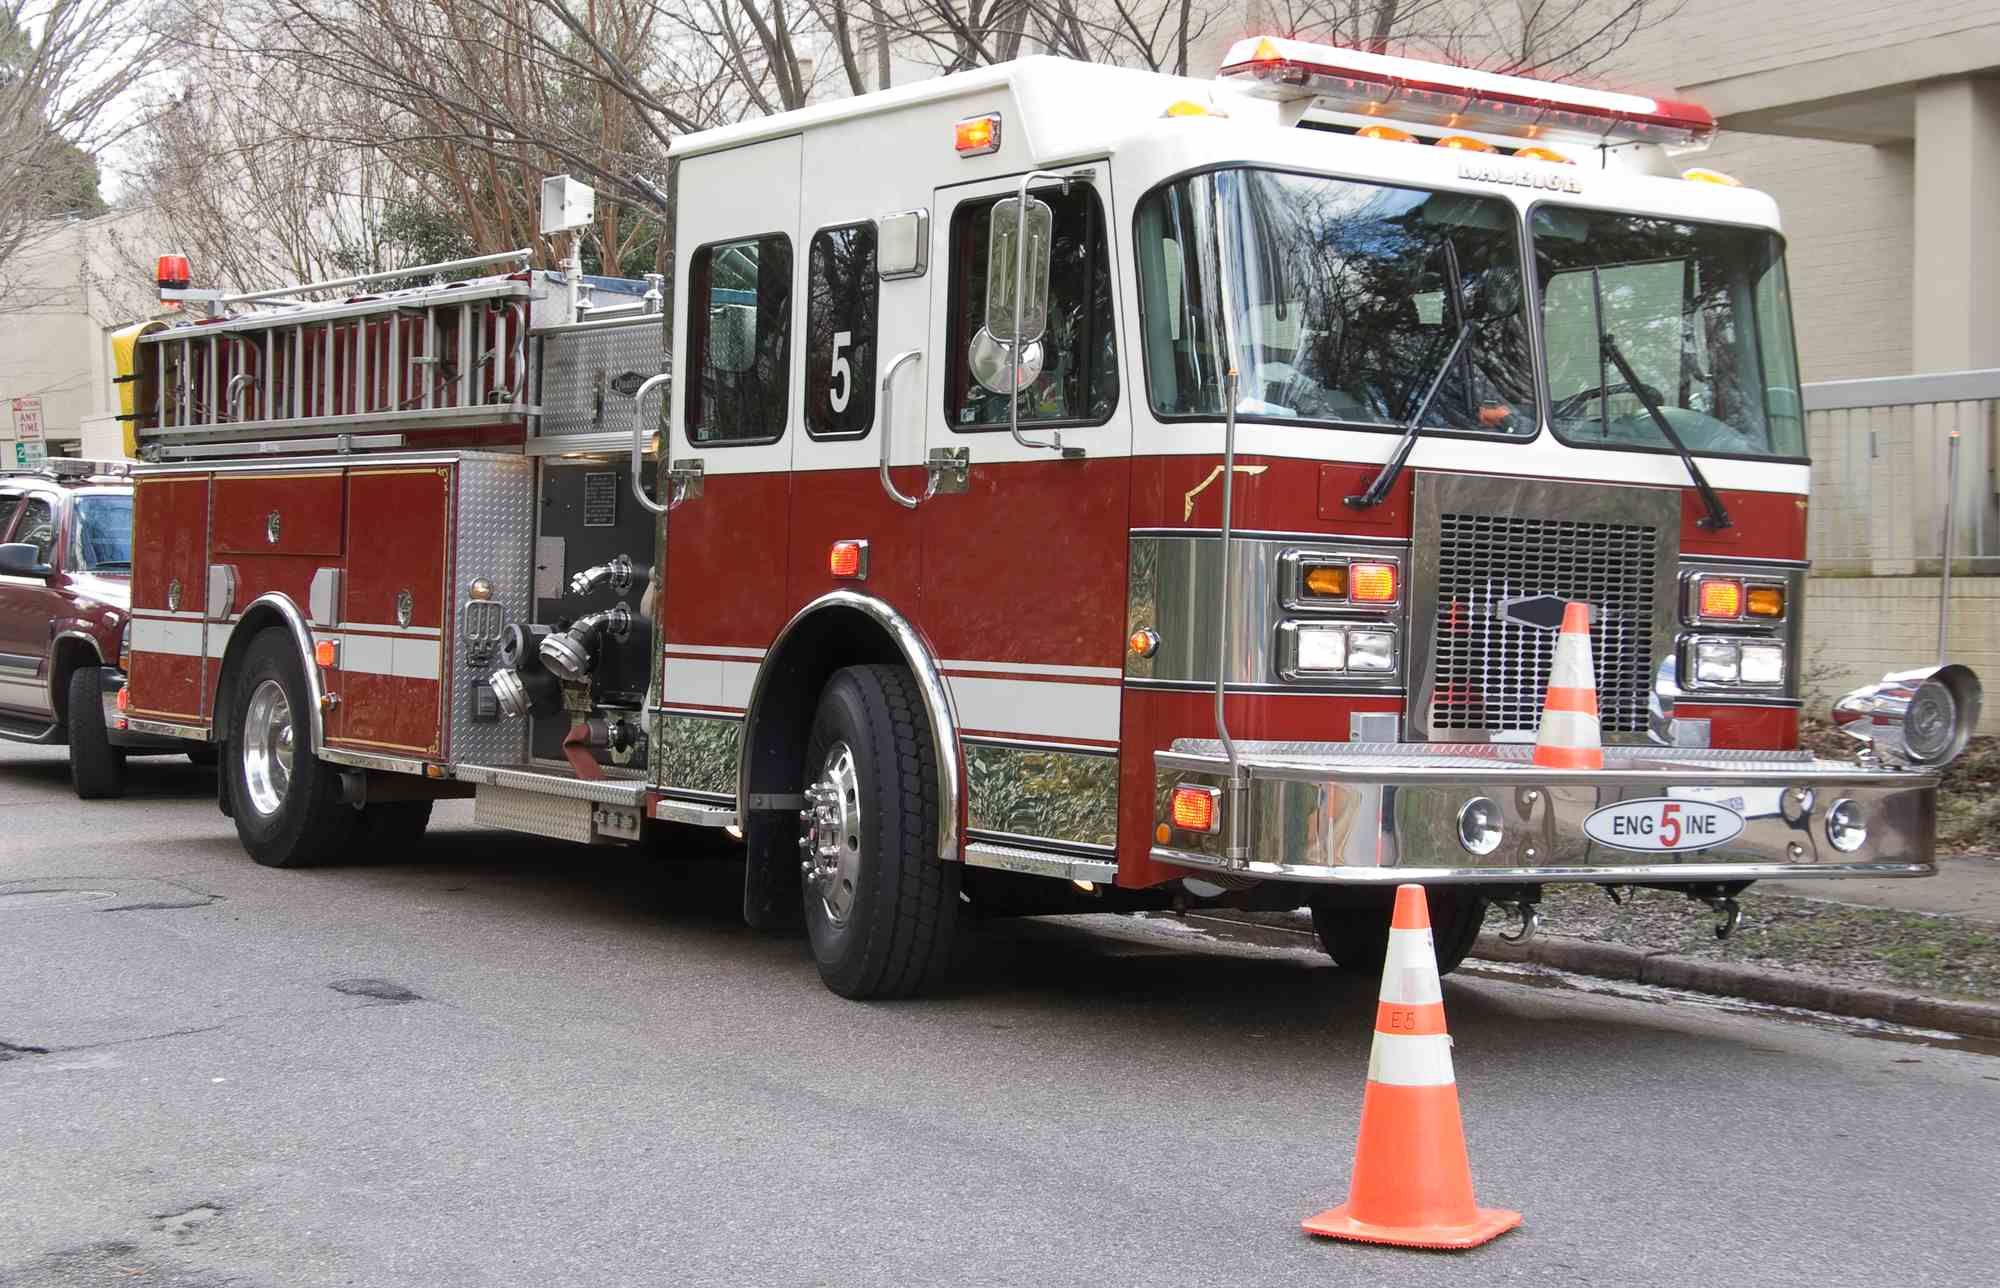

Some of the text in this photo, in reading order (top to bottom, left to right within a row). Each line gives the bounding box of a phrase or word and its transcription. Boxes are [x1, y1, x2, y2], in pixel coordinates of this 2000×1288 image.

[830, 331, 851, 413] 5
[21, 413, 37, 422] ANY
[20, 423, 40, 433] TIME
[1659, 804, 1681, 847] 5
[1391, 1010, 1416, 1030] E5
